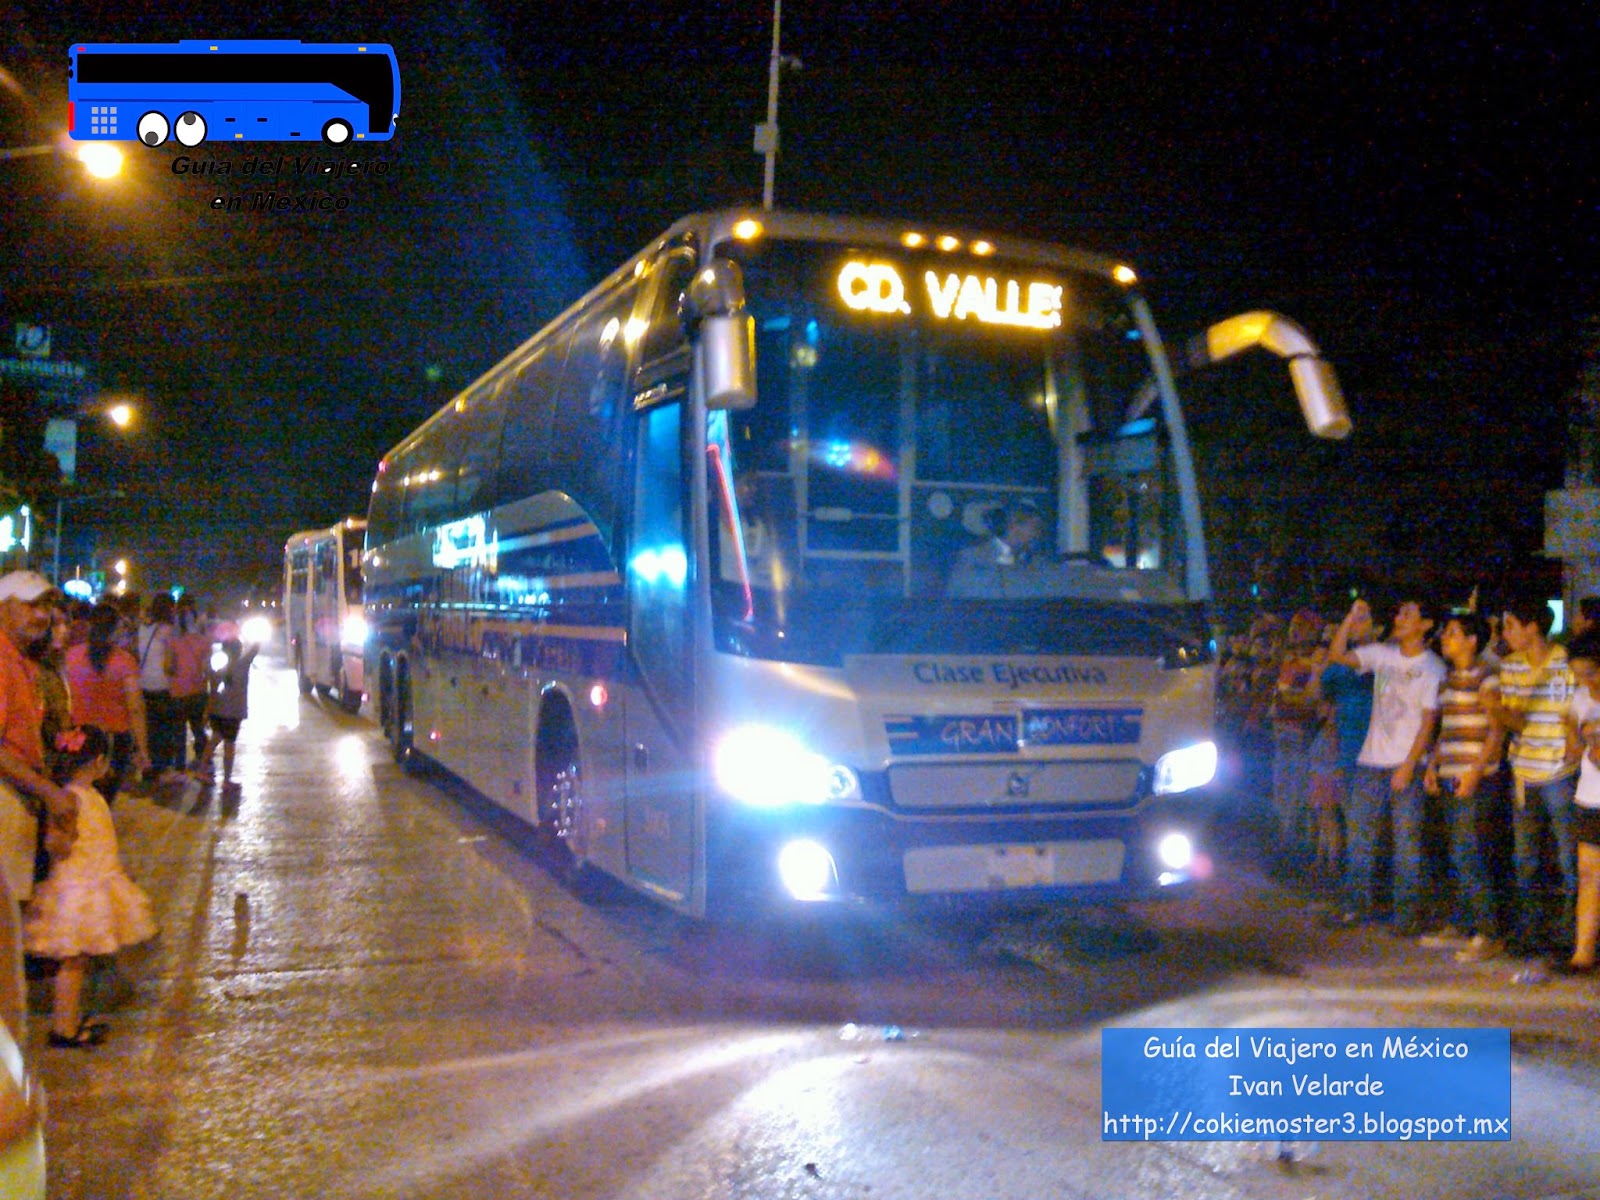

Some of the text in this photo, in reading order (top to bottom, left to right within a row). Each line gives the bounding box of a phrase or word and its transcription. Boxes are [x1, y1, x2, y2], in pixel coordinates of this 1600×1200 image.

[913, 664, 1108, 689] Clase Ejecutiva
[940, 720, 1014, 752] GRAN
